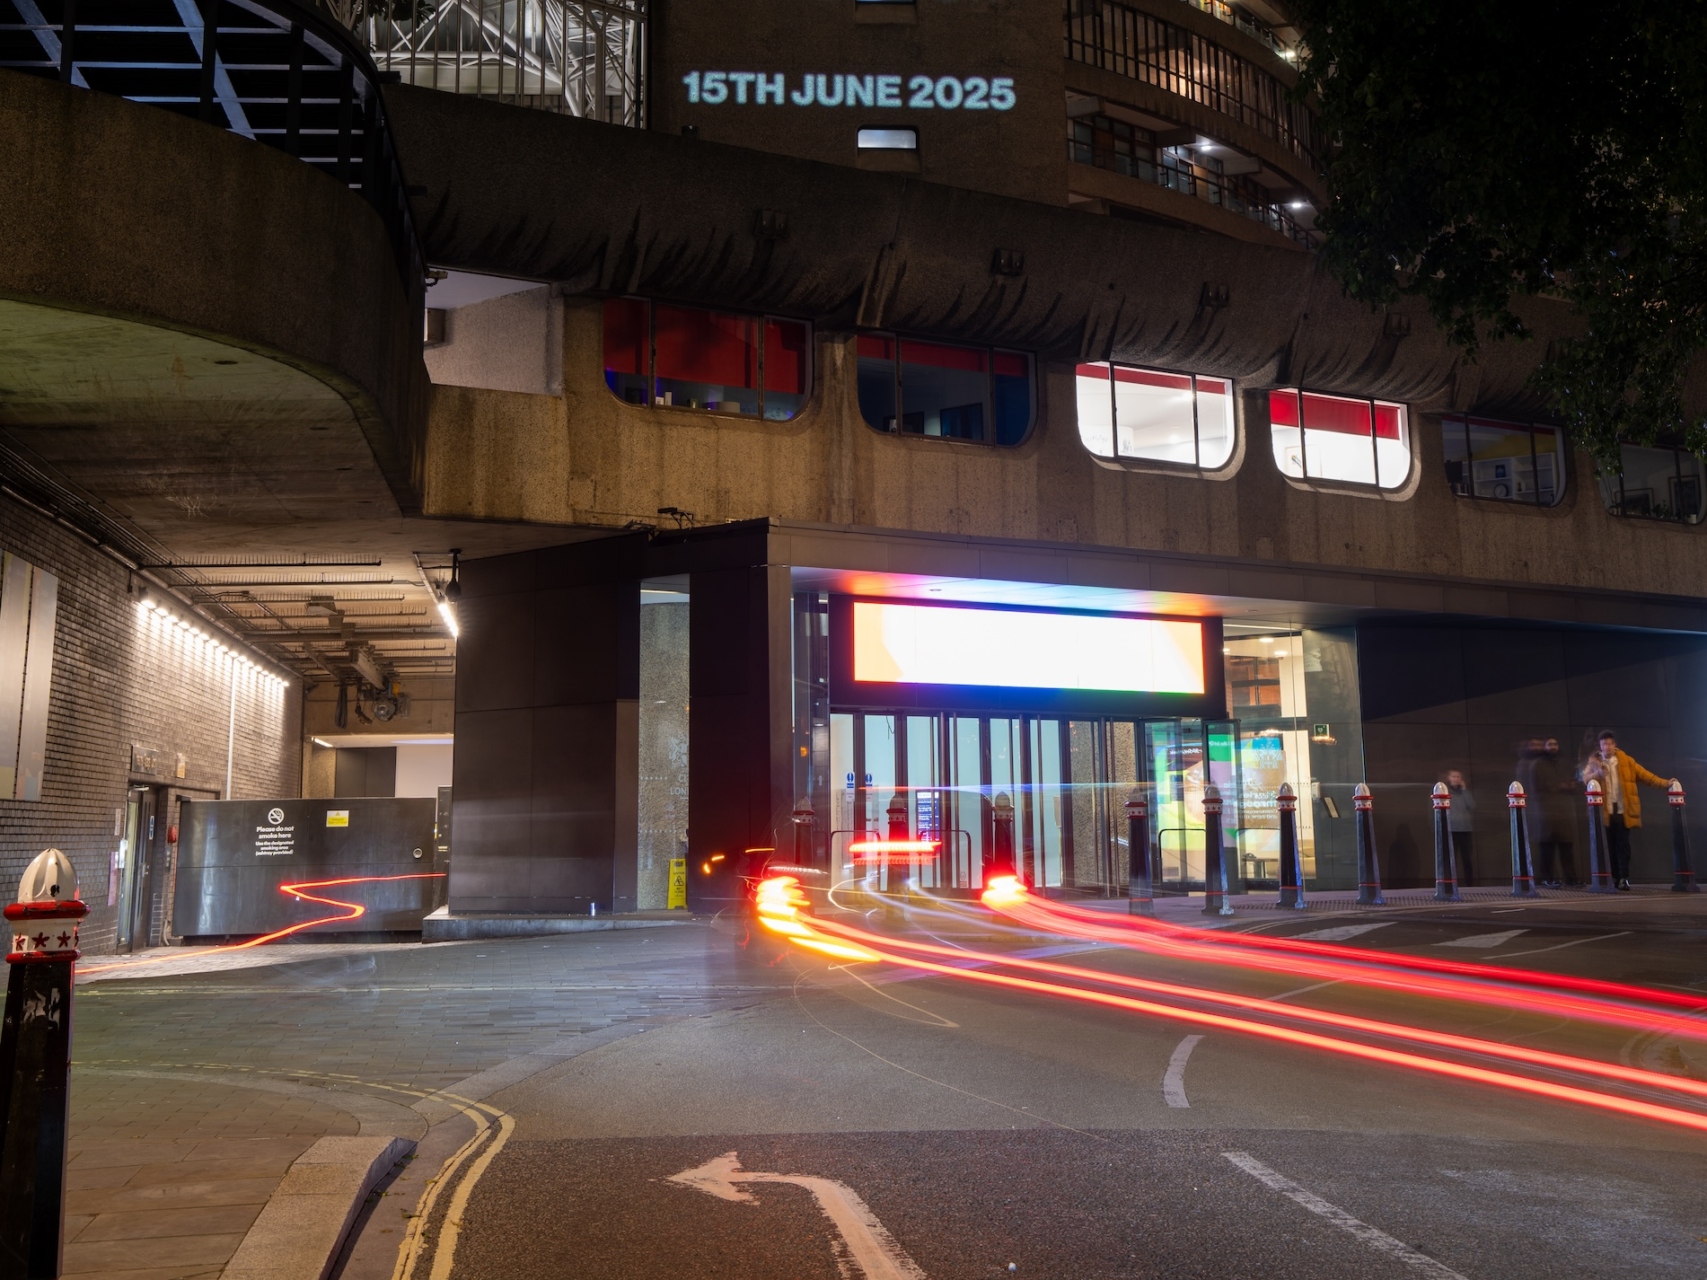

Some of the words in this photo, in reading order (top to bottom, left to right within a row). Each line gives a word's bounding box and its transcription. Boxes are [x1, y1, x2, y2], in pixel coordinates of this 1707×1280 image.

[682, 71, 785, 105] 15TH
[790, 74, 902, 108] JUNE
[908, 75, 1017, 110] 2025
